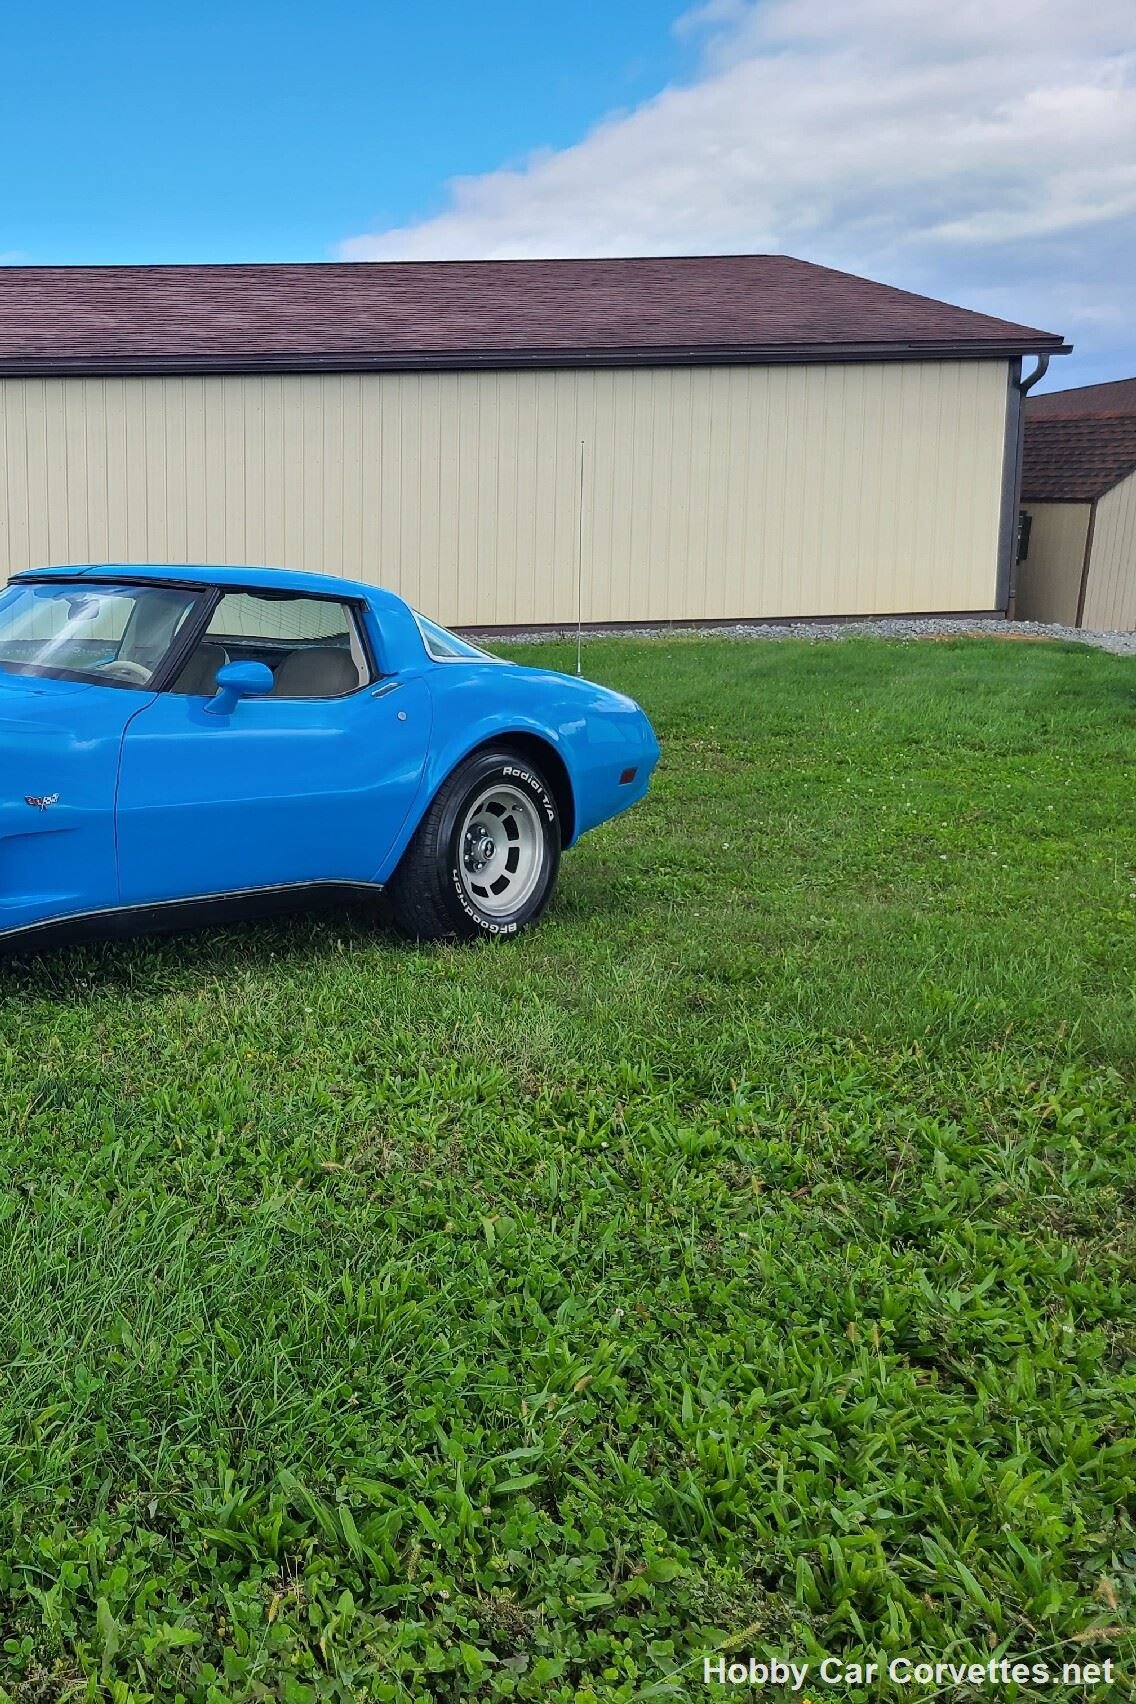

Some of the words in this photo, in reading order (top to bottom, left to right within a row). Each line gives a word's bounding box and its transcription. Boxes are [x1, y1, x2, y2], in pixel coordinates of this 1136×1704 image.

[502, 765, 543, 794] Radial
[542, 794, 554, 822] T/A
[452, 868, 517, 934] BFGoodrich
